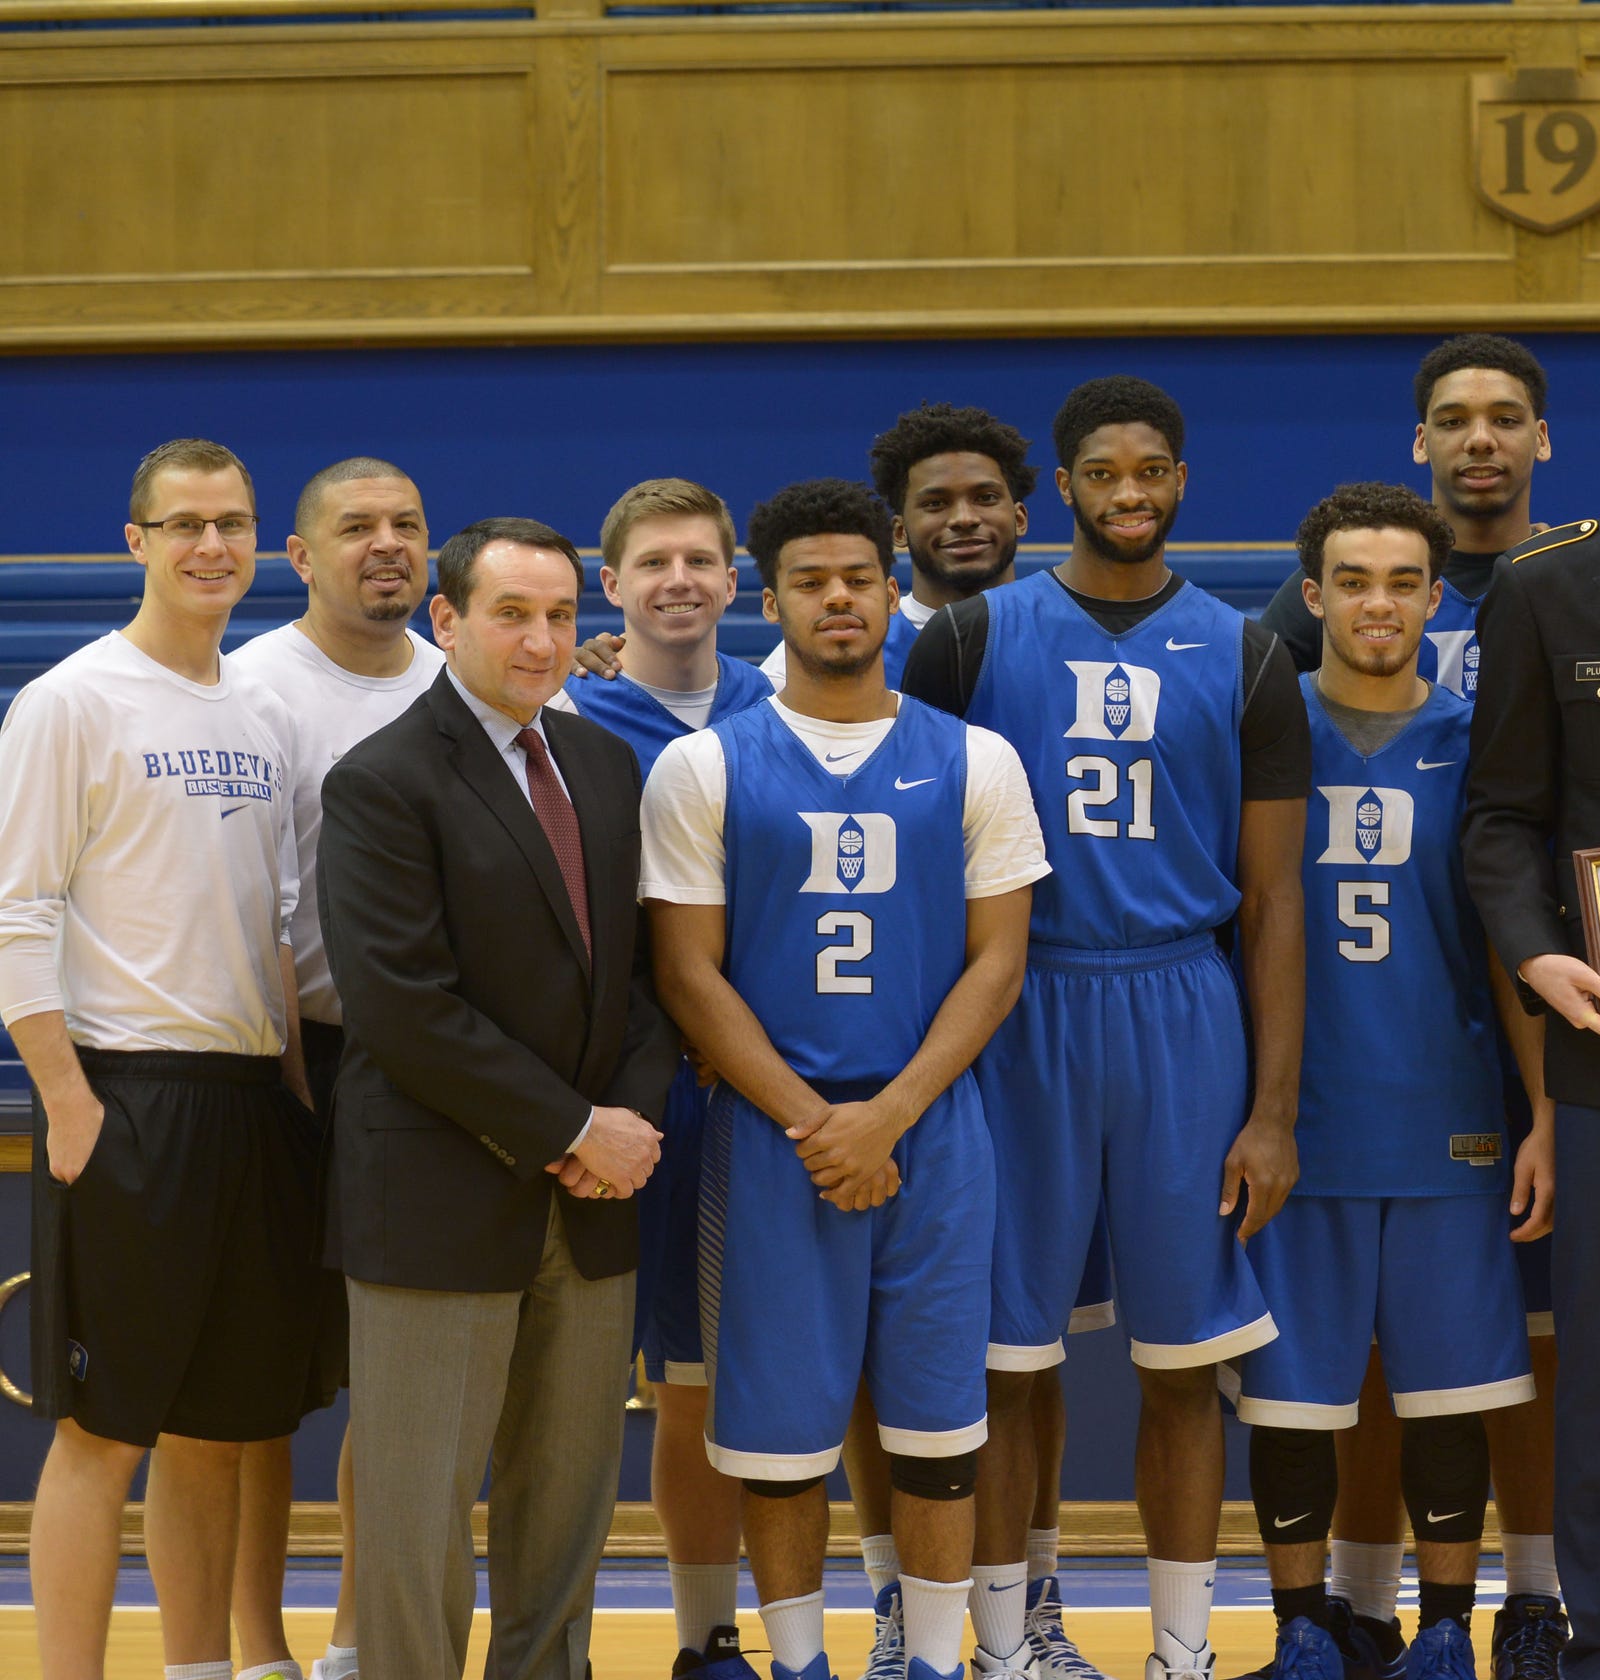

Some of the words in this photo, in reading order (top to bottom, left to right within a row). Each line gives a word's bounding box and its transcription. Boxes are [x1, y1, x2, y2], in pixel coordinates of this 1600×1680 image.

[1496, 110, 1598, 196] 19
[1063, 660, 1161, 742] D
[142, 749, 283, 792] BLUEDEVIS
[186, 780, 271, 801] BASETBALL
[1065, 755, 1157, 841] 21
[798, 811, 897, 894] D
[1316, 785, 1414, 866] D
[815, 910, 874, 994] 2
[1337, 880, 1391, 962] 5
